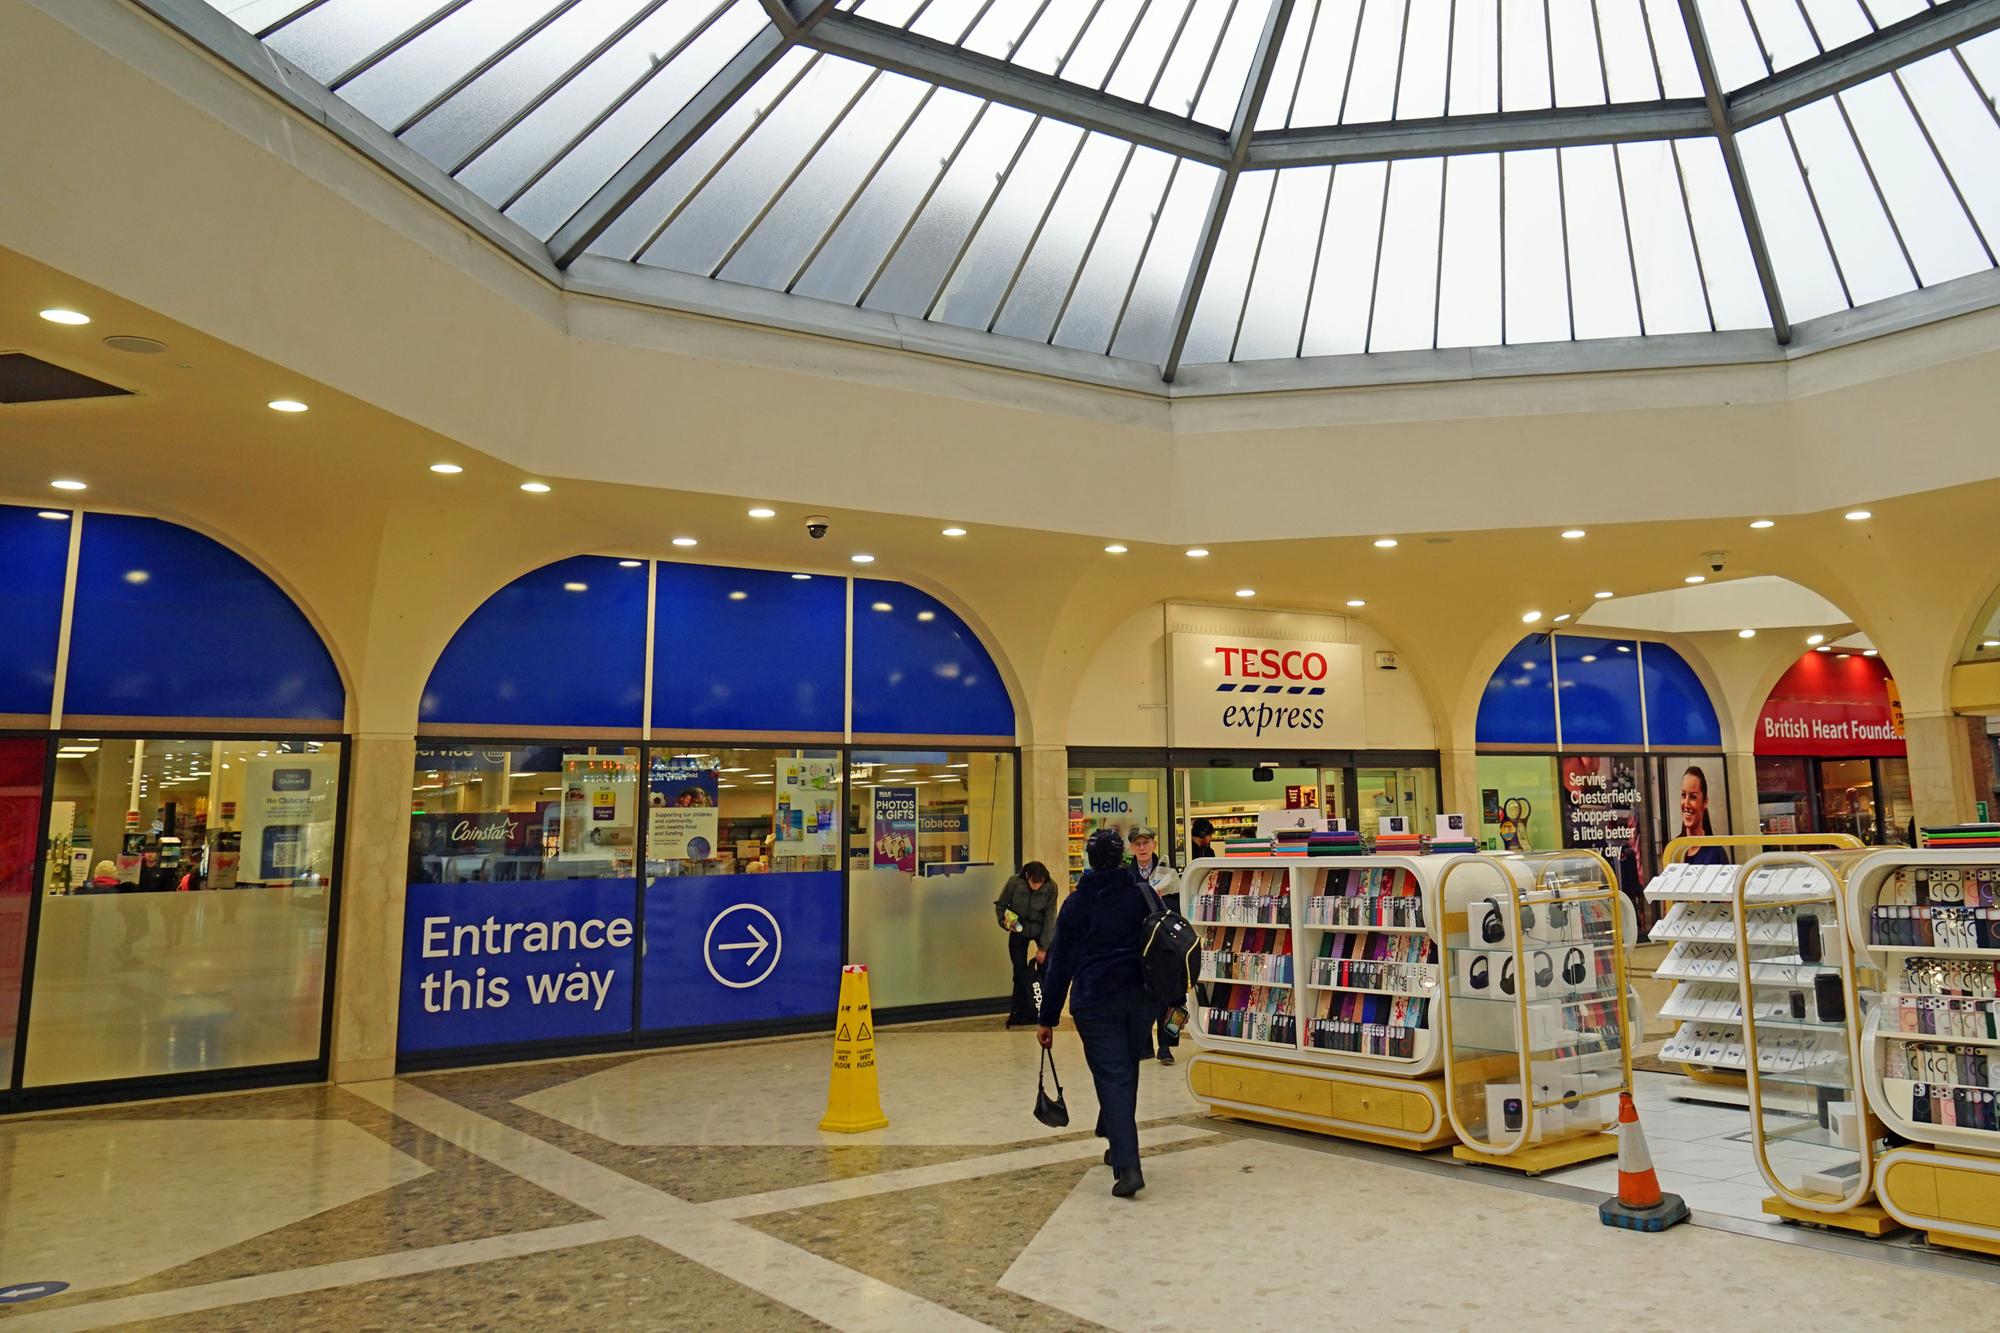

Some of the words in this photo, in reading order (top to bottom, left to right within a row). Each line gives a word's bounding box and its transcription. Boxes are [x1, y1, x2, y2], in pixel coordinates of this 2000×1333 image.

[1215, 647, 1328, 681] TESCO
[1223, 702, 1324, 737] express
[1764, 717, 1808, 739] British
[1812, 719, 1848, 740] Heart
[1852, 720, 1905, 741] Founda
[1569, 772, 1607, 789] Serving
[876, 800, 915, 810] PHOTOS
[1090, 797, 1132, 813] Hello.
[1570, 789, 1642, 806] Chesterfield's
[876, 810, 883, 820] &
[886, 810, 915, 820] GIFTS
[919, 818, 961, 828] Tobacco
[1571, 807, 1618, 824] shoppers
[451, 819, 508, 841] Coinstar
[1573, 830, 1579, 841] a
[1581, 826, 1604, 841] little
[1605, 825, 1636, 839] better
[1605, 843, 1623, 861] day
[421, 916, 634, 958] Entrance
[420, 967, 510, 1013] this
[526, 967, 615, 1012] way
[856, 1060, 874, 1069] FLOOR
